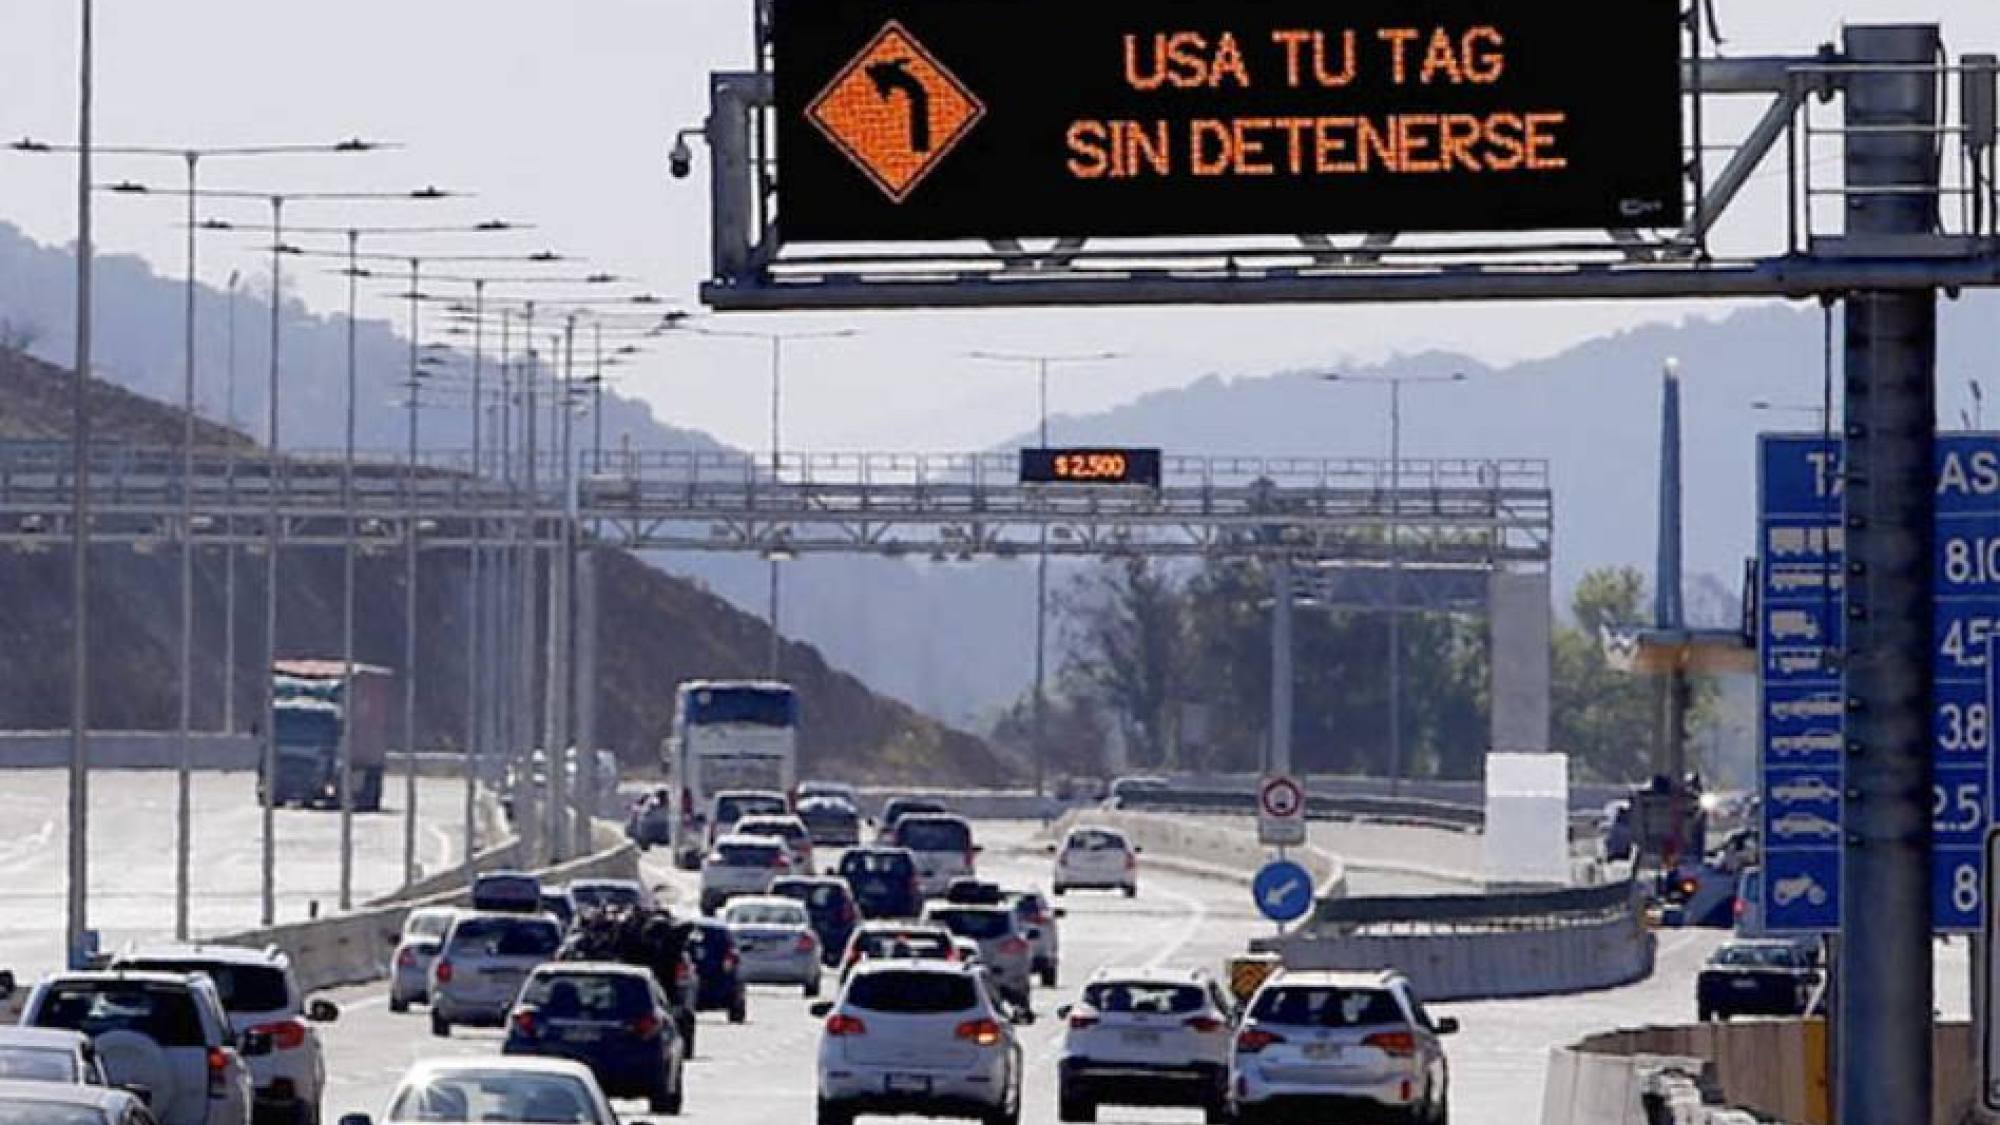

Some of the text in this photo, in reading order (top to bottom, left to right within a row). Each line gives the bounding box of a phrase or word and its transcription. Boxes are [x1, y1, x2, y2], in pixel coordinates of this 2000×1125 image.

[1124, 26, 1504, 89] USA TU TAG
[1066, 112, 1568, 178] SIN DETENERSE
